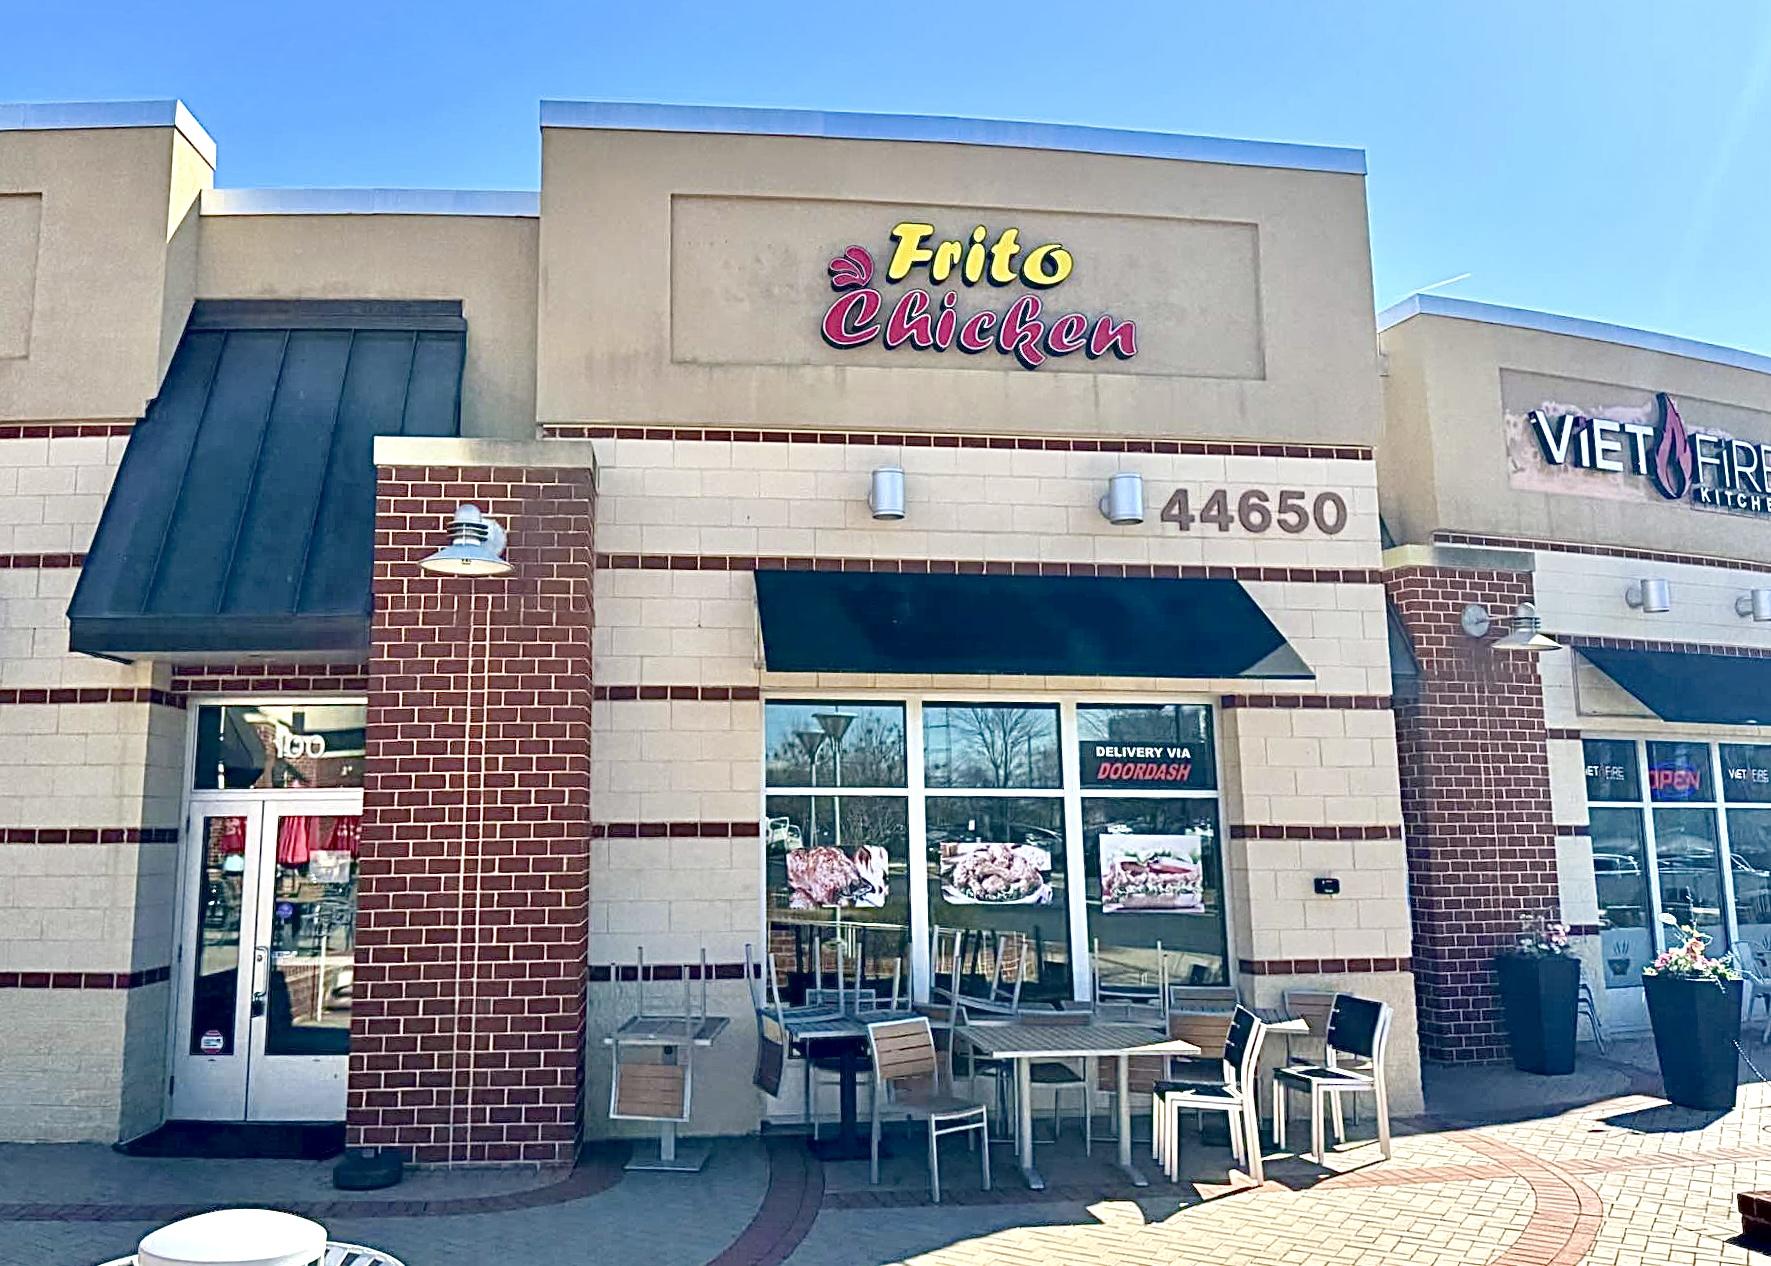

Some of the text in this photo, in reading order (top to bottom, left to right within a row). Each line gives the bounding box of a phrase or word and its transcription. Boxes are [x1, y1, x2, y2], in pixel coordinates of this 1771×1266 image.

[887, 222, 1073, 288] Frito
[822, 288, 1137, 370] Chicken
[1529, 409, 1654, 475] VIET
[1160, 488, 1348, 535] 44650
[273, 733, 326, 759] 100
[1095, 746, 1191, 758] DELIVERY VIA
[1097, 762, 1192, 781] DOORDASH
